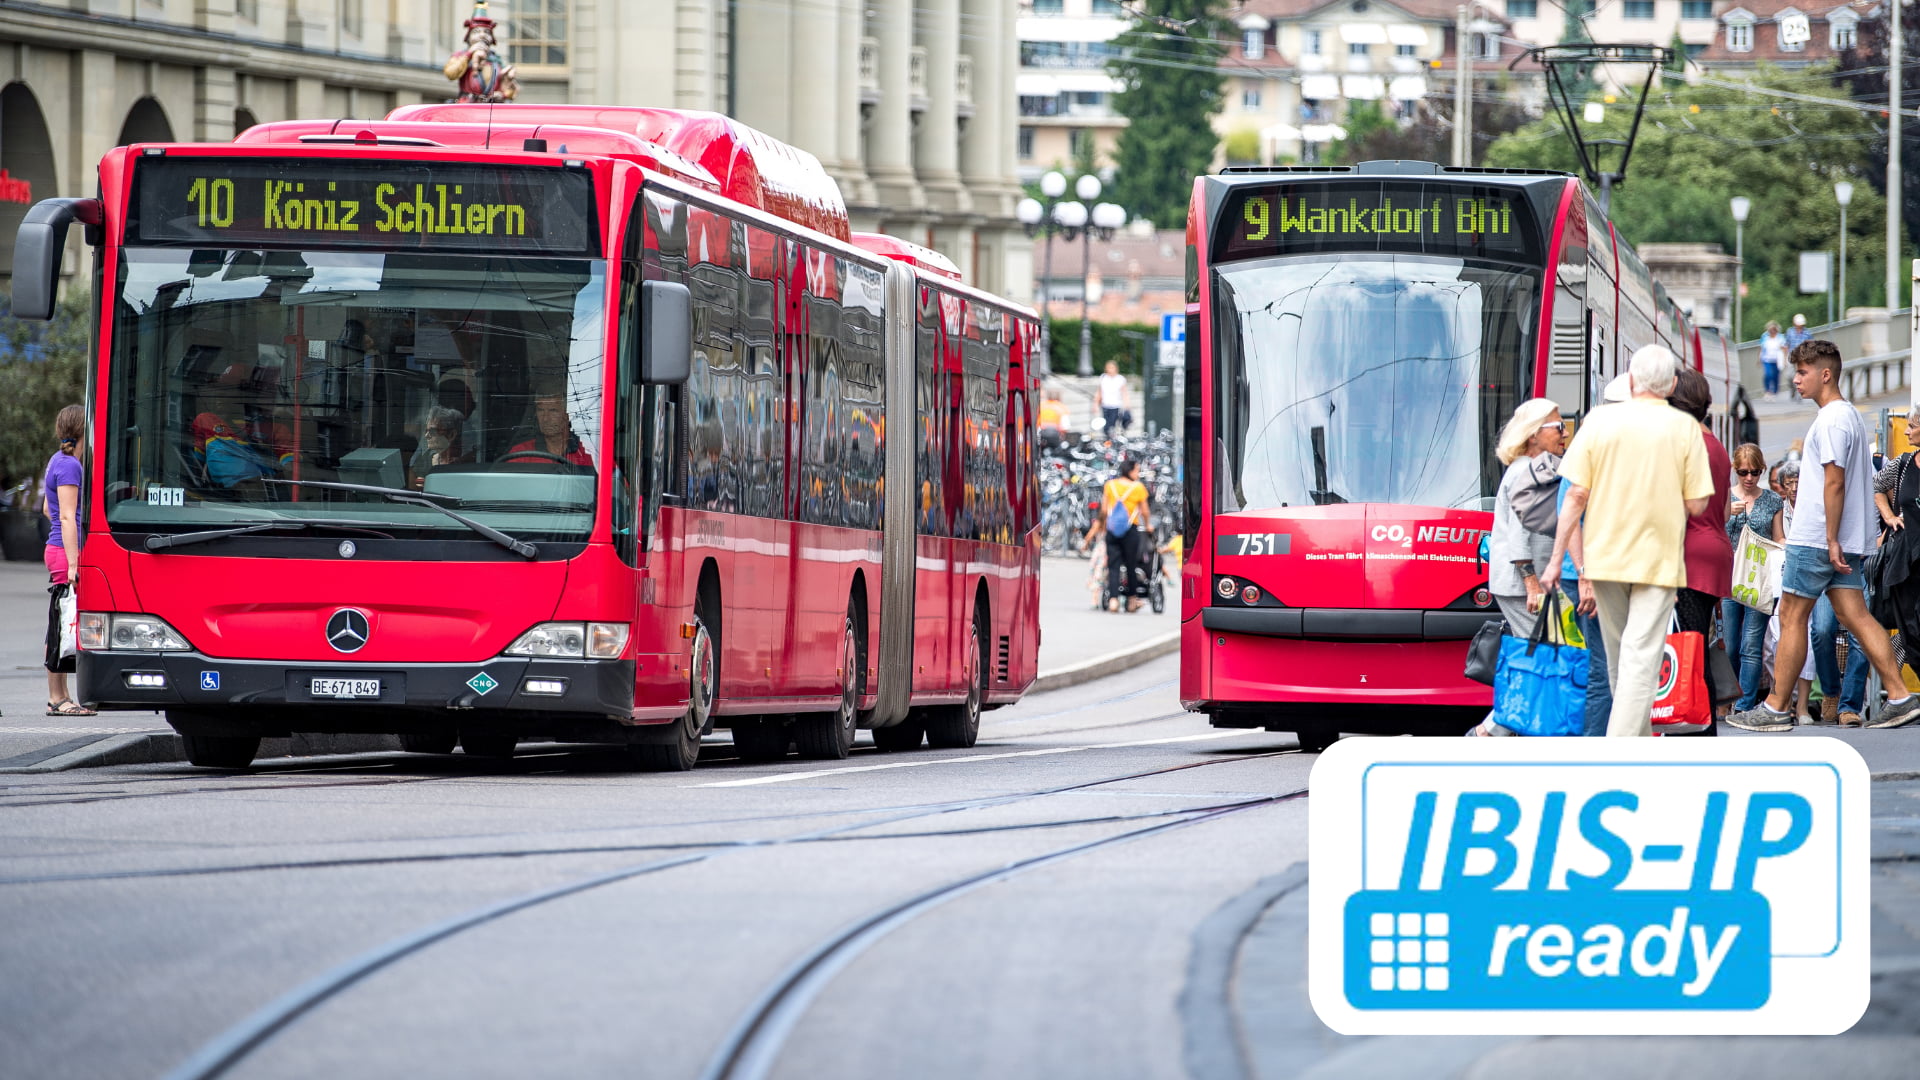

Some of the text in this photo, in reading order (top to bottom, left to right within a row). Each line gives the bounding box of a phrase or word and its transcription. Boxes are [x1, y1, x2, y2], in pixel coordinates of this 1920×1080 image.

[187, 177, 525, 235] 10 Köniz Schliern
[1244, 197, 1269, 240] 9
[1280, 197, 1442, 233] Wankdorf
[1170, 316, 1185, 341] P
[1237, 533, 1275, 556] 751
[1346, 552, 1363, 560] fährt
[473, 680, 492, 688] CNG
